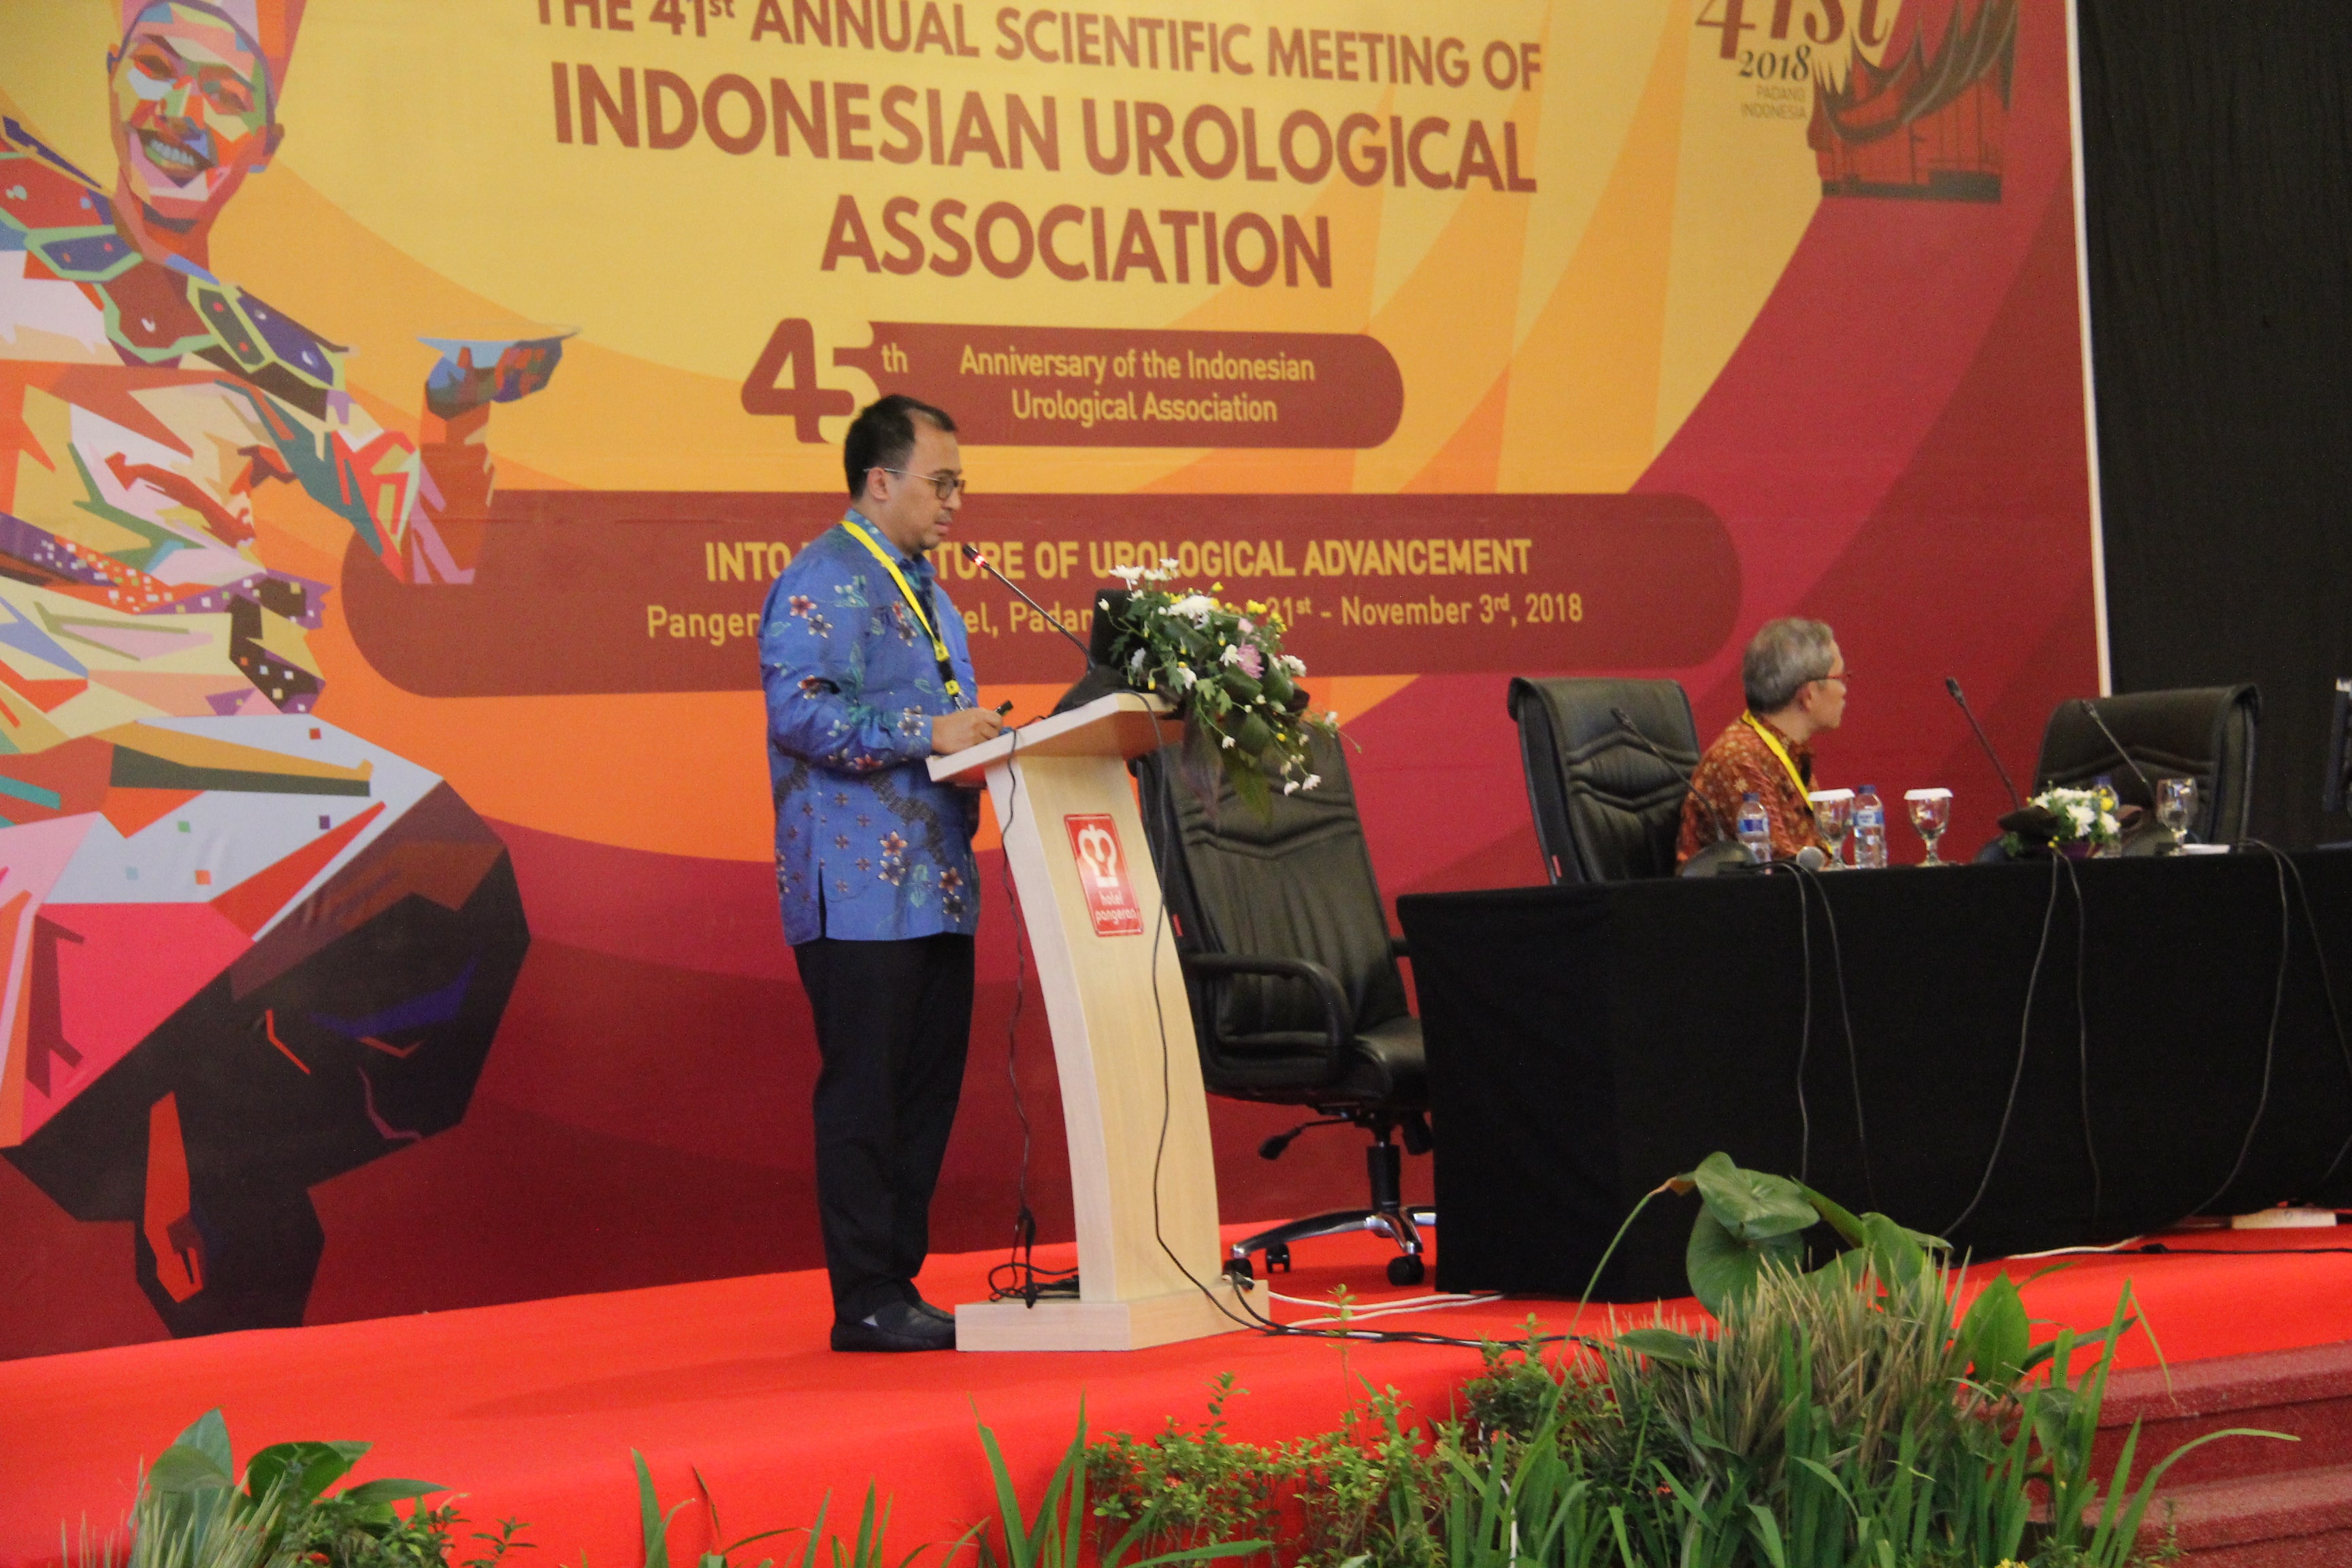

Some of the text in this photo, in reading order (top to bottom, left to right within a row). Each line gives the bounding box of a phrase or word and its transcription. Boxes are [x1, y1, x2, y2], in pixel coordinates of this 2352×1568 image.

[750, 0, 980, 57] ANNUAL
[994, 7, 1254, 76] SCIENTIFIC
[1267, 25, 1470, 88] MEETING
[1483, 39, 1542, 91] OF
[1738, 43, 1811, 82] 2018
[551, 61, 1538, 193] INDONESIAN UROLOGICAL
[1740, 102, 1806, 119] INDONESIA
[819, 193, 1333, 289] ASSOCIATION
[960, 344, 1316, 386] Anniversary of the Indonesian
[1011, 389, 1278, 428] Urological Association
[705, 542, 792, 581] INTO
[1034, 541, 1079, 579] OF
[1303, 538, 1532, 576] ADVANCEMENT
[648, 604, 760, 647] Panger
[1341, 594, 1473, 625] November
[1479, 593, 1518, 627] 3rd,
[1525, 593, 1583, 623] 2018
